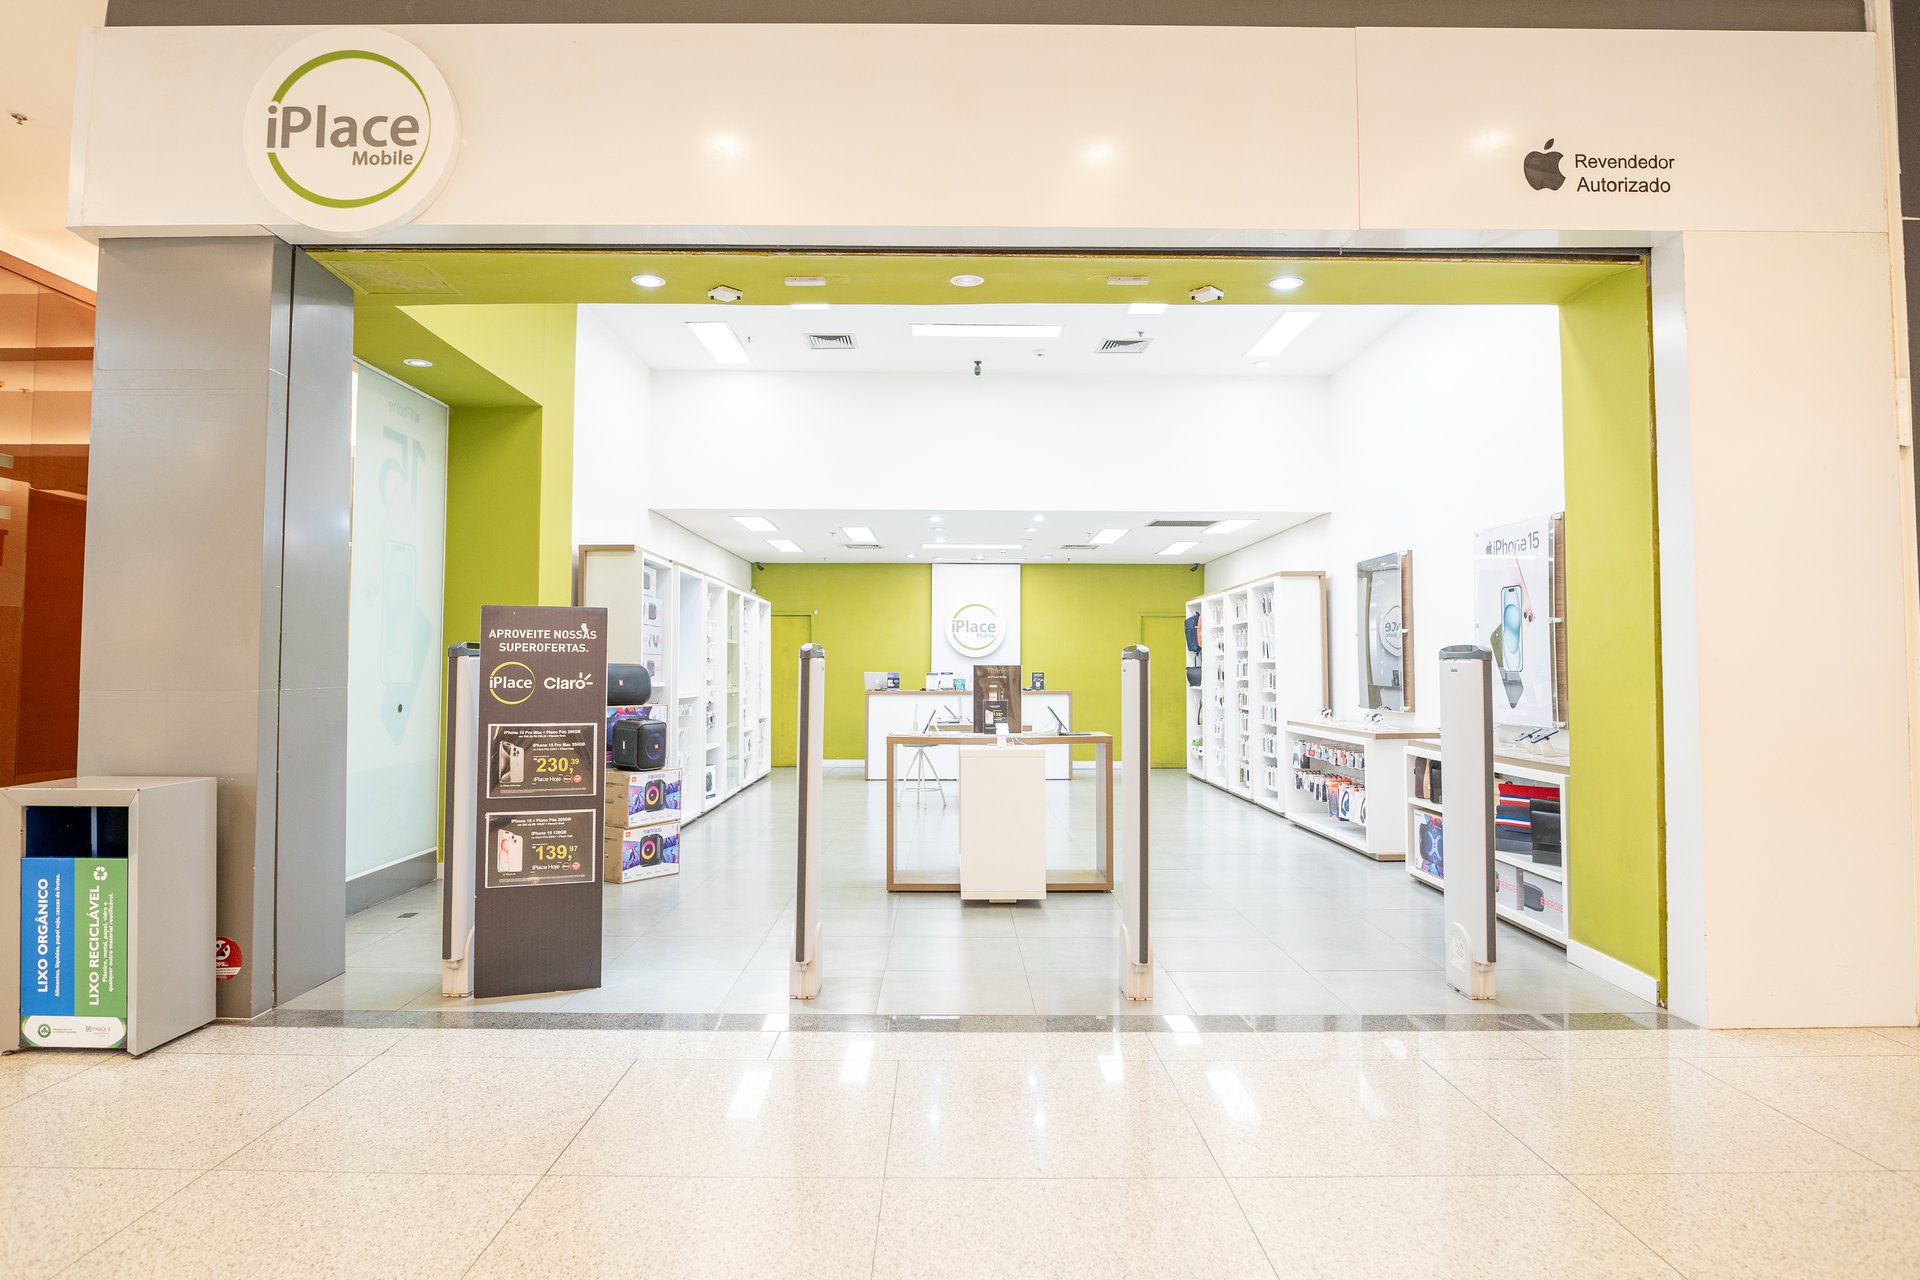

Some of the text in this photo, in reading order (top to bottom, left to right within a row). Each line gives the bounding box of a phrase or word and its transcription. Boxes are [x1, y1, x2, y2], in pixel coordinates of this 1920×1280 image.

[266, 105, 420, 149] iPlace
[352, 150, 413, 166] Mobile
[1575, 154, 1675, 169] Revendedor
[1577, 177, 1671, 192] Autorizado
[1493, 530, 1540, 557] iPhone 15
[952, 620, 996, 632] iPlace
[489, 629, 597, 639] APROVEITE NOSSAS
[499, 643, 589, 652] SUPEROFERTAS.
[490, 676, 586, 689] iPlace Claro
[35, 878, 48, 992] LIXO ORGÂNICO
[86, 885, 100, 1005] LIXO RECICLÁVEL
